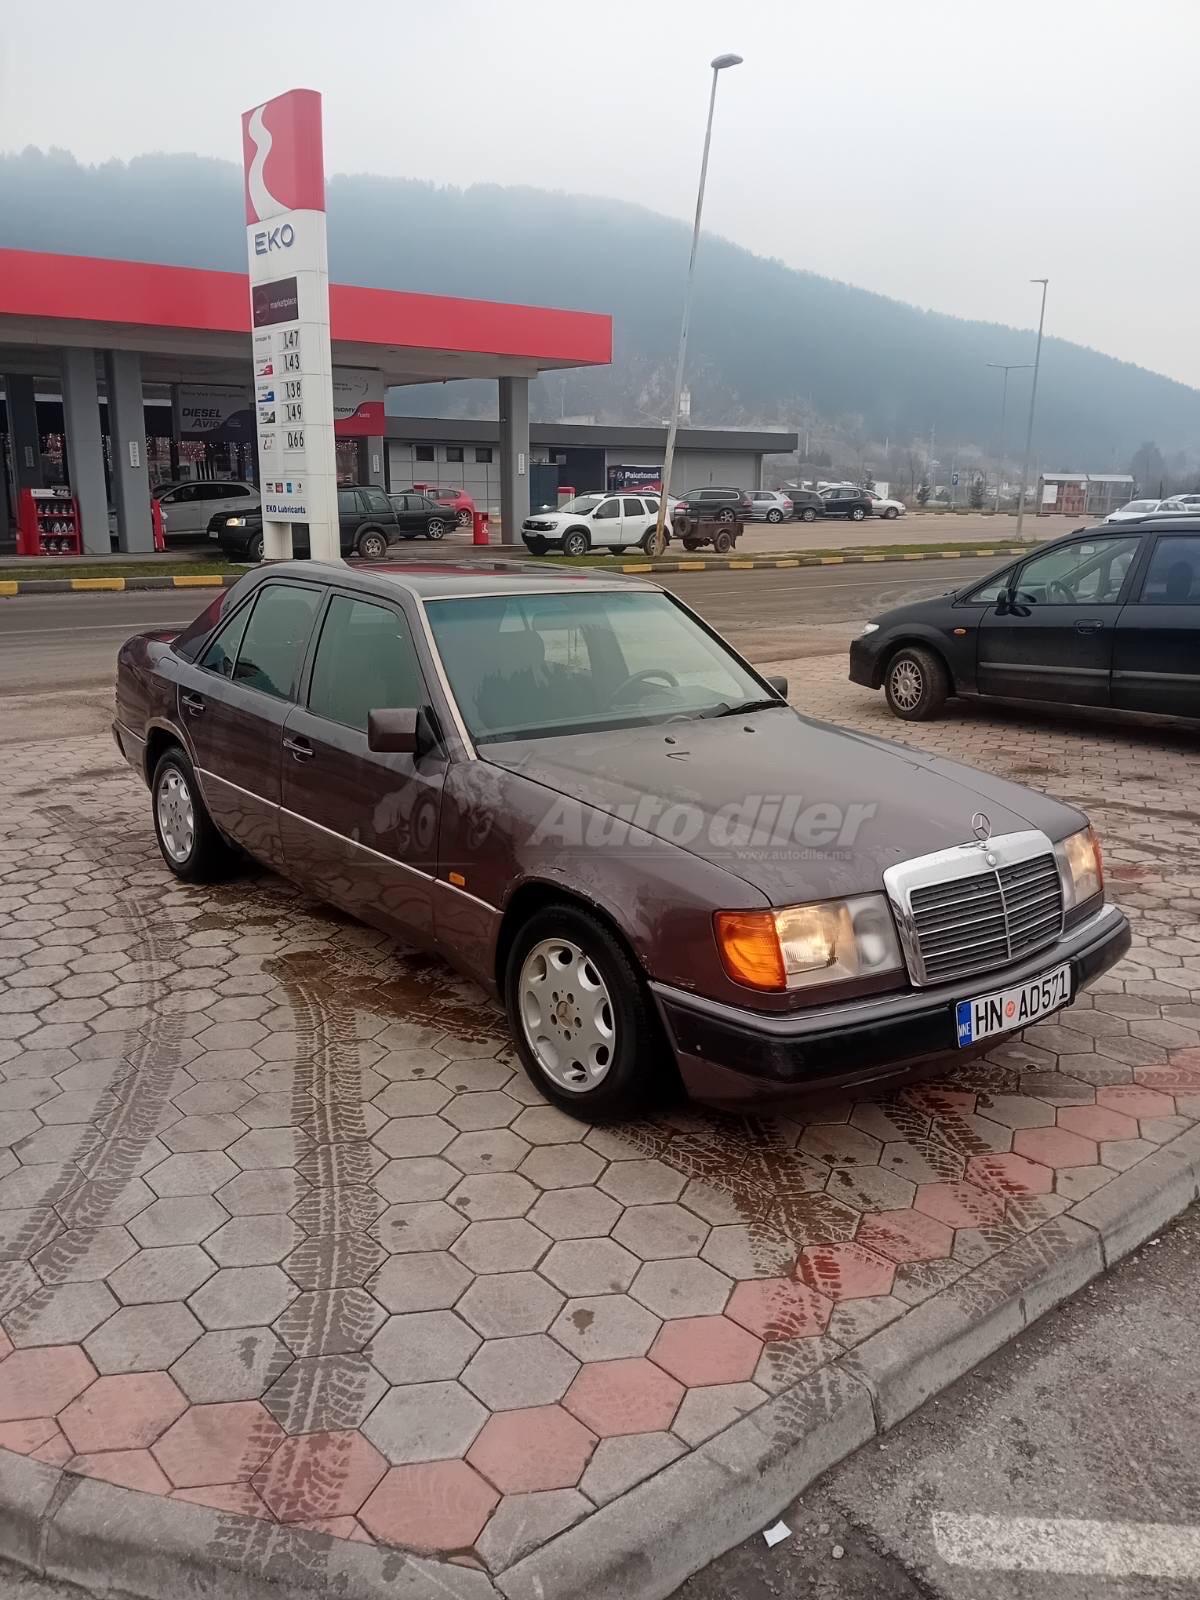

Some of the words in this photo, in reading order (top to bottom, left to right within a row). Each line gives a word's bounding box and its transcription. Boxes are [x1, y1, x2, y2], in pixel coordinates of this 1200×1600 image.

[254, 223, 294, 255] EKO
[182, 408, 222, 418] DIESEL
[624, 471, 660, 479] Paketomat
[265, 504, 277, 513] EKO
[277, 505, 306, 514] Lubricants
[975, 997, 1003, 1036] HN
[1018, 970, 1068, 1022] AD571
[958, 1021, 971, 1037] MNE
